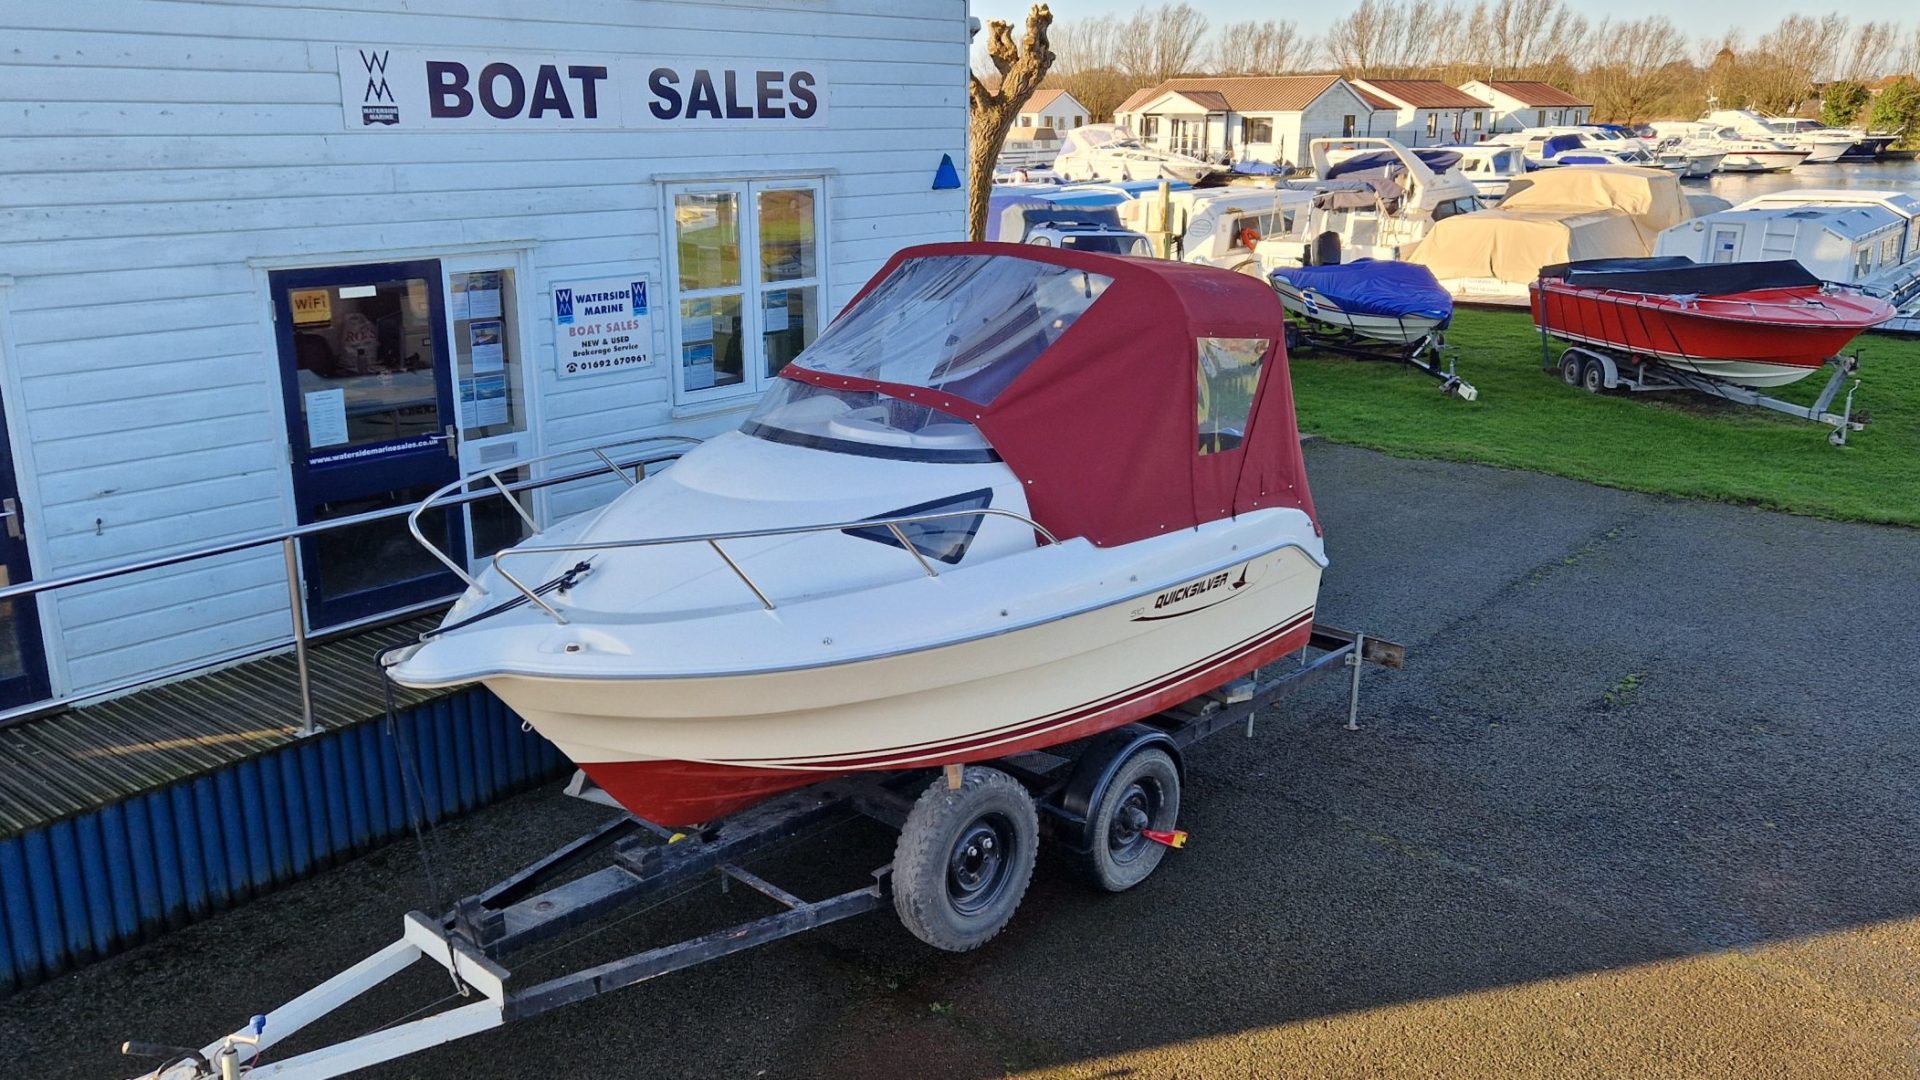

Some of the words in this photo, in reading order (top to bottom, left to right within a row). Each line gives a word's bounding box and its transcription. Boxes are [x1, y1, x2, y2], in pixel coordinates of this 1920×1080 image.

[426, 60, 608, 119] BOAT
[648, 67, 818, 119] SALES
[575, 290, 630, 304] WATERSIDE
[584, 303, 624, 316] MARINE
[569, 324, 602, 337] BOAT
[606, 320, 639, 333] SALES
[581, 339, 599, 348] NEW
[611, 336, 630, 344] USED
[573, 347, 611, 358] Brokerage
[613, 343, 639, 352] Service
[580, 359, 611, 370] 01692
[614, 354, 647, 366] 670961
[309, 439, 438, 465] www.watersidemarinesales.co.uk
[1154, 571, 1229, 609] QUICKSILVER
